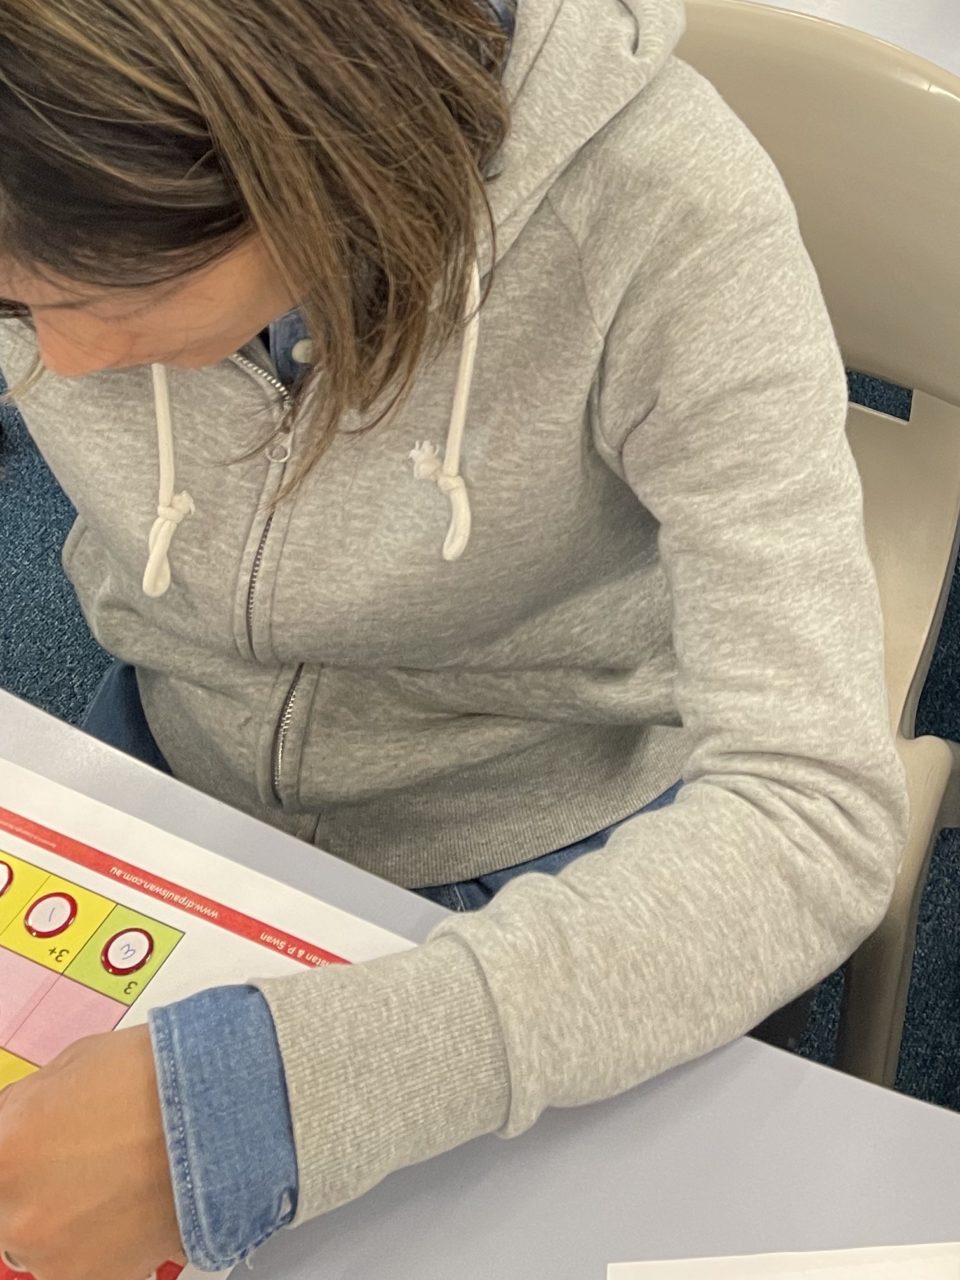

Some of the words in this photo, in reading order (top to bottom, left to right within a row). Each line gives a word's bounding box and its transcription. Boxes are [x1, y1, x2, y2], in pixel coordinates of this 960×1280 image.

[109, 865, 220, 920] www.drpaulswan.com.au
[259, 931, 287, 952] Swan
[286, 942, 296, 955] P.
[48, 945, 70, 963] 3+
[296, 947, 305, 959] &
[123, 980, 138, 996] 3
